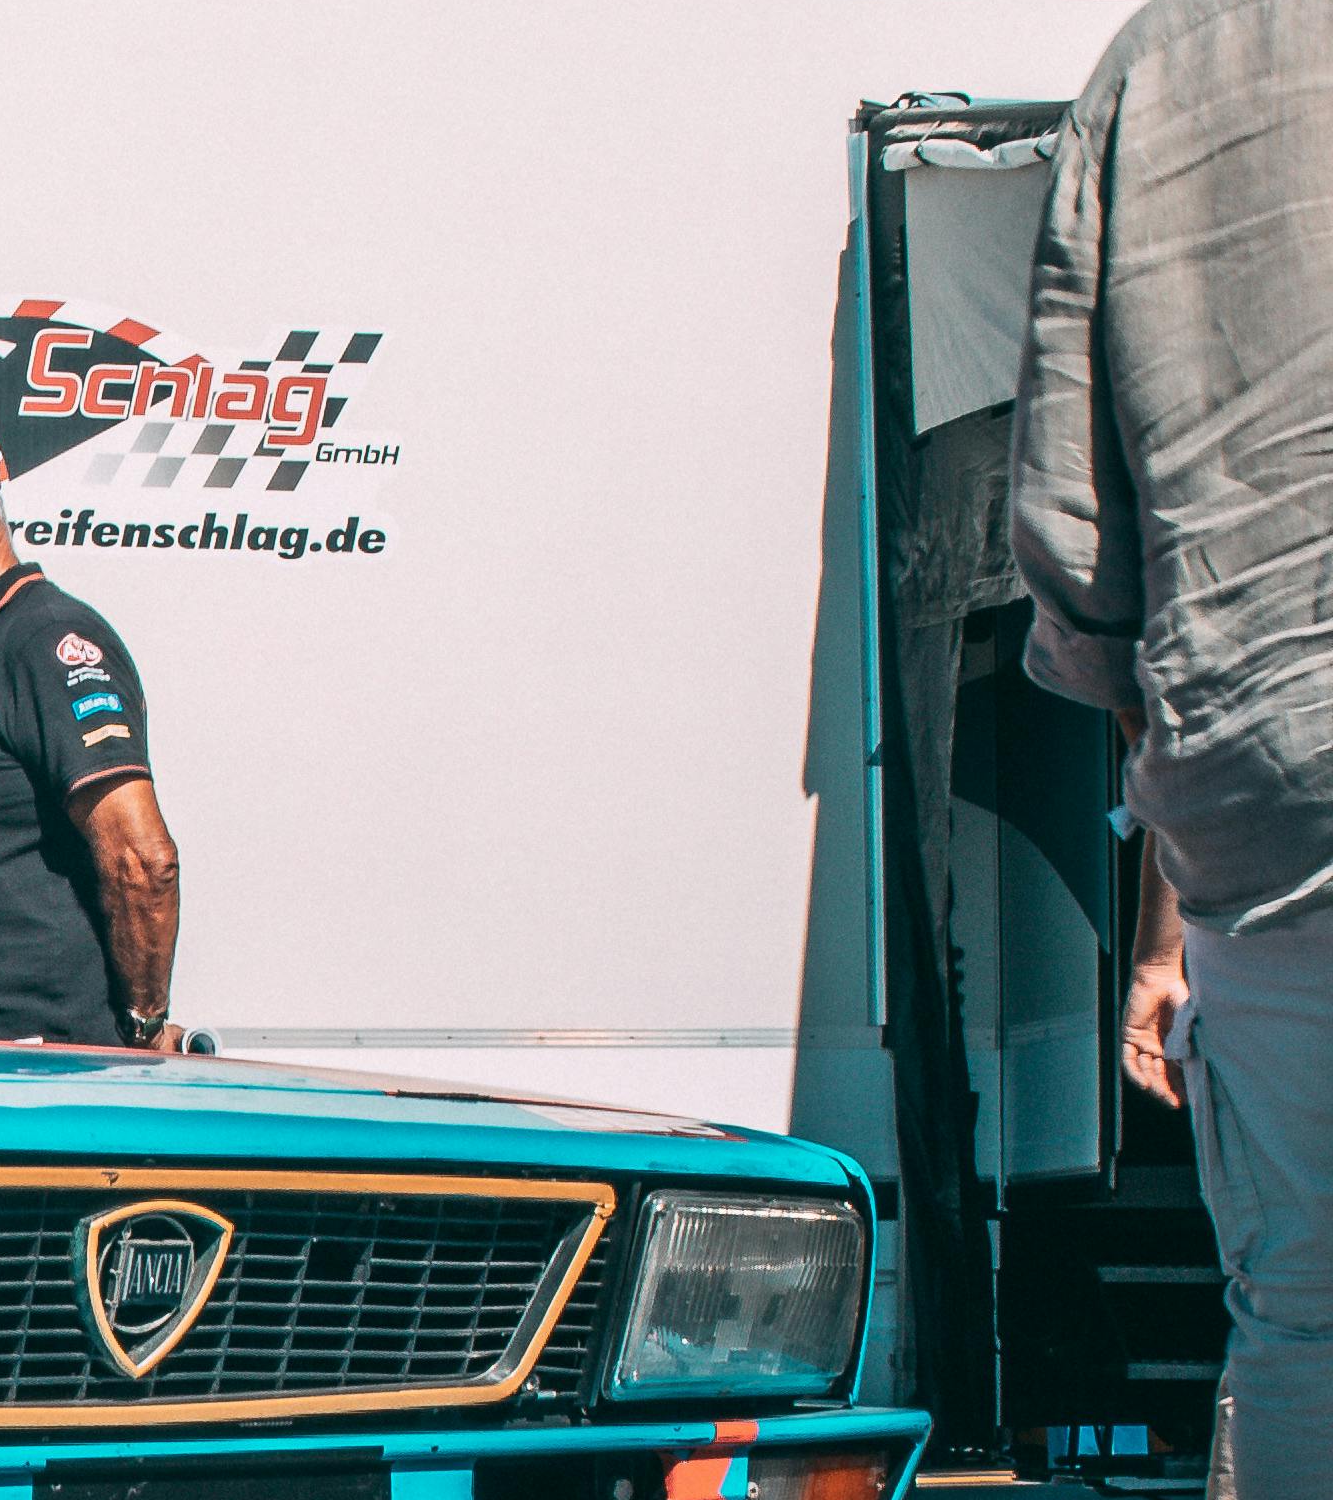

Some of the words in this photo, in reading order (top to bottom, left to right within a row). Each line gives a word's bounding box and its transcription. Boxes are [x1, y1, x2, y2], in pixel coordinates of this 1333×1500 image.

[19, 329, 329, 446] Schlag
[315, 442, 401, 466] GmbH
[121, 1247, 183, 1300] LANCIA
